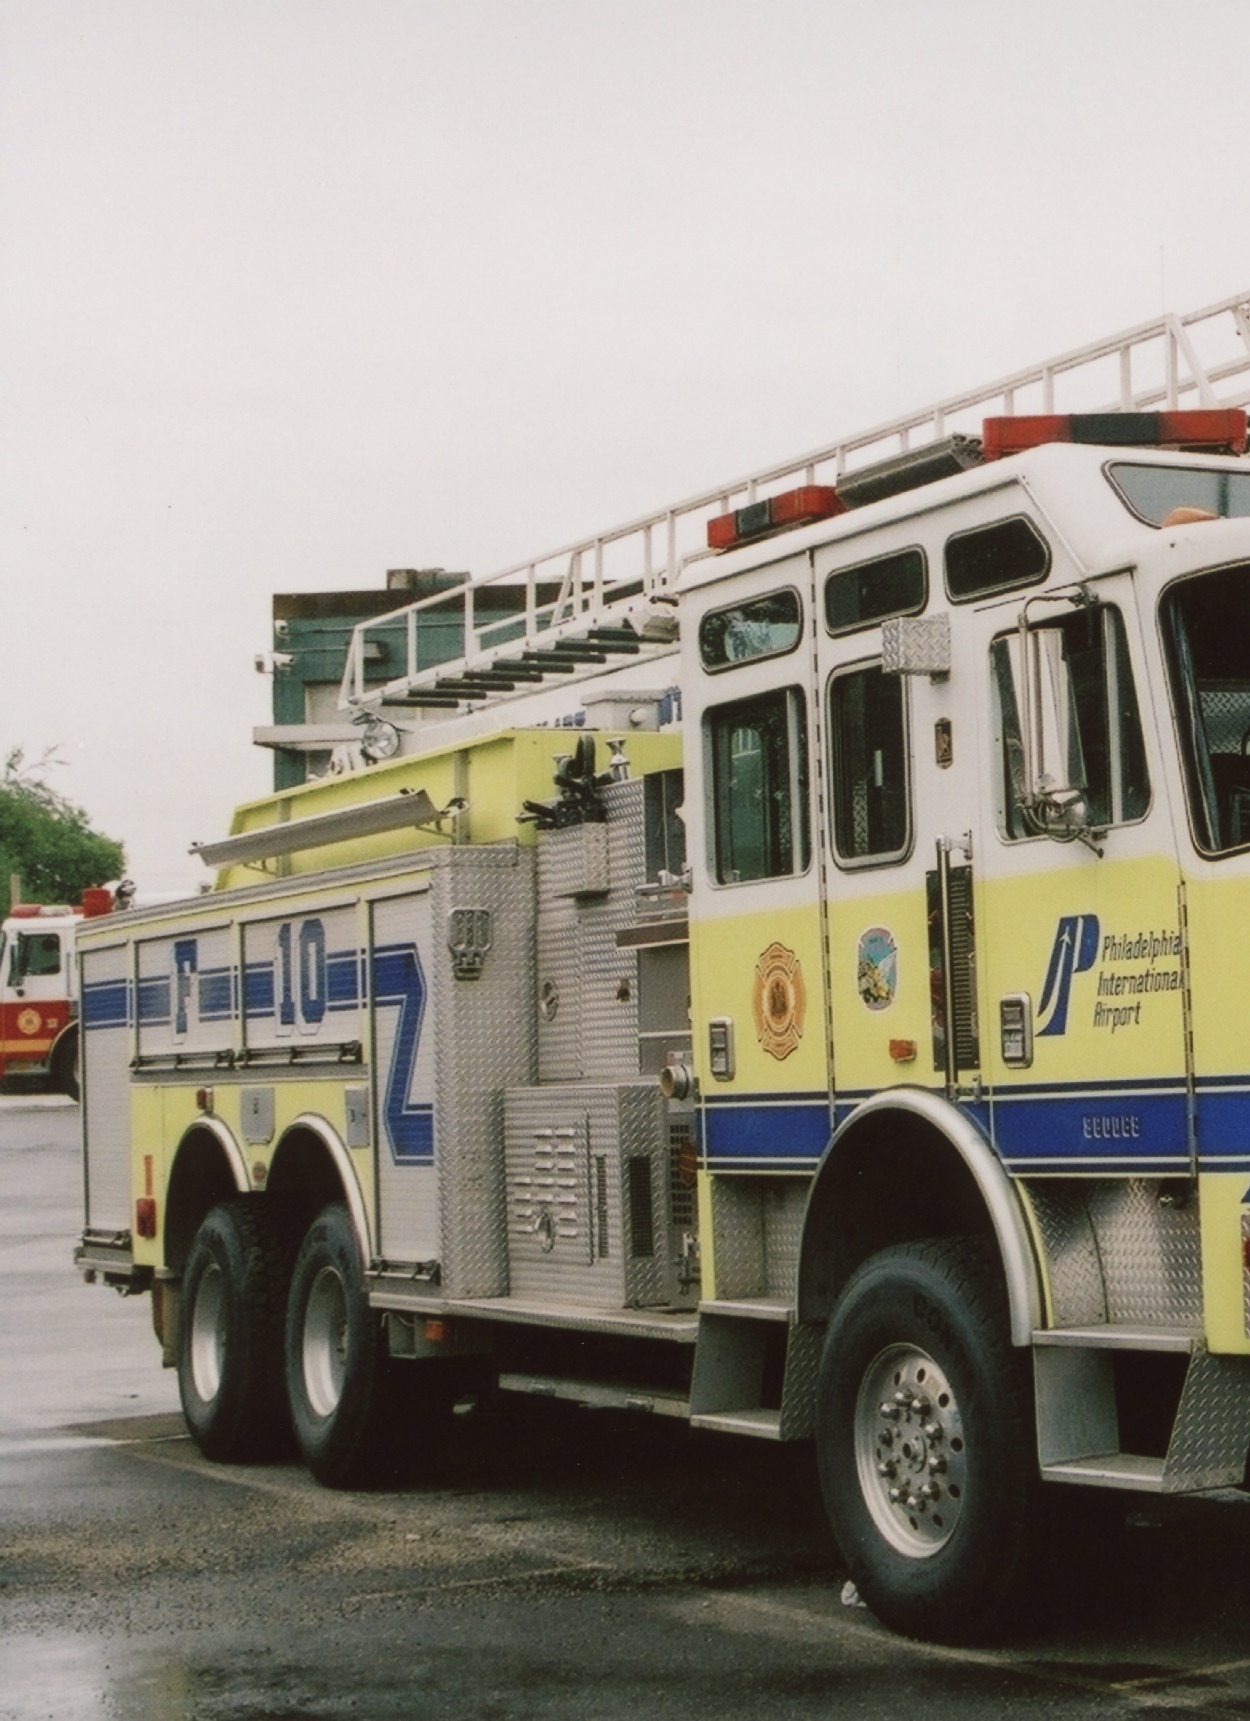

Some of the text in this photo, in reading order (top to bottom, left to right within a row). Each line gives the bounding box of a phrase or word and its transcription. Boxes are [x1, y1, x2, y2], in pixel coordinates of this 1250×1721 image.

[1101, 930, 1183, 964] Philadelphia
[276, 918, 326, 1031] 10
[1097, 968, 1185, 996] International
[1093, 1001, 1141, 1034] Airport
